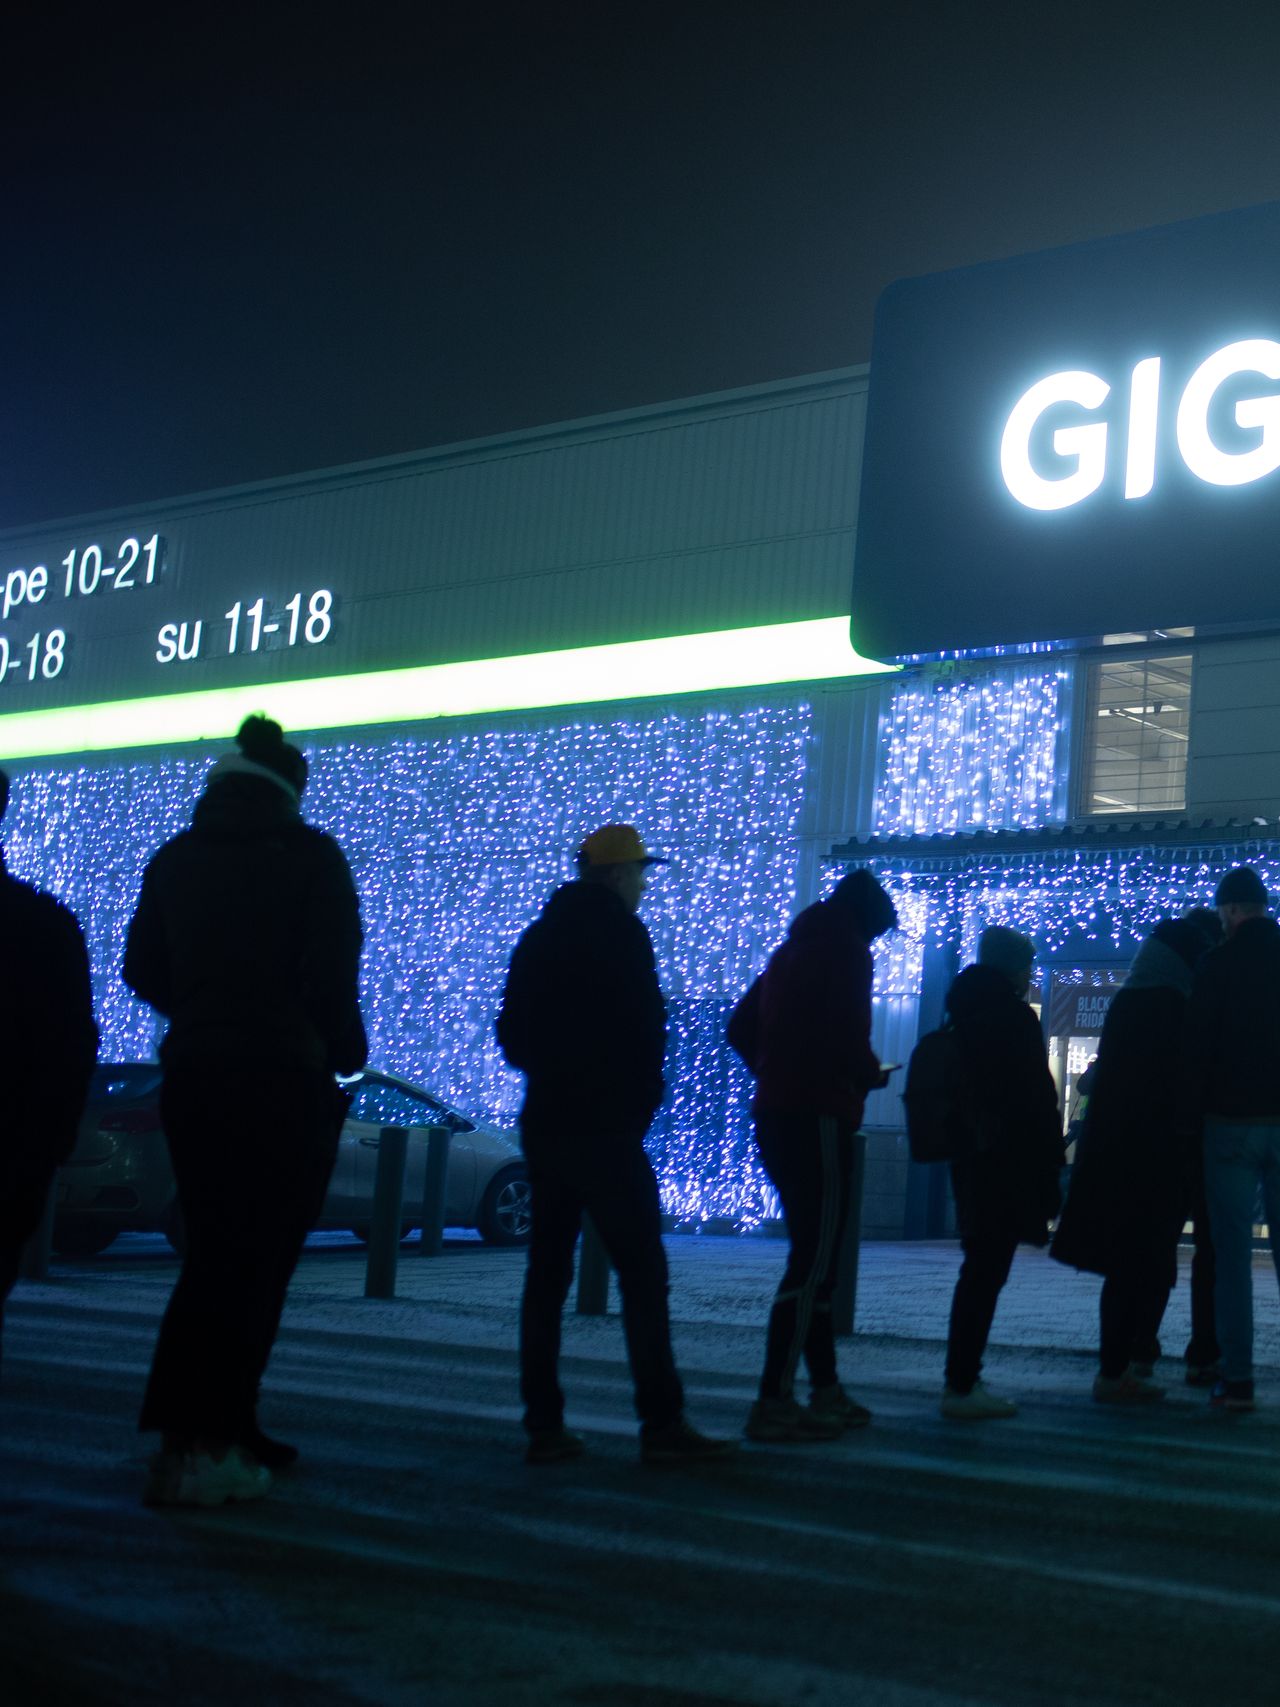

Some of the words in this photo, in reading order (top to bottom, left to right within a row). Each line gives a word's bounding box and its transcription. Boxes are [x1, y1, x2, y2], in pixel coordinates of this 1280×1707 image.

[62, 533, 159, 597] 10-21
[155, 620, 202, 664] su
[225, 589, 333, 654] 11-18
[1075, 1012, 1107, 1028] FRIDA
[1078, 996, 1112, 1012] BLACK
